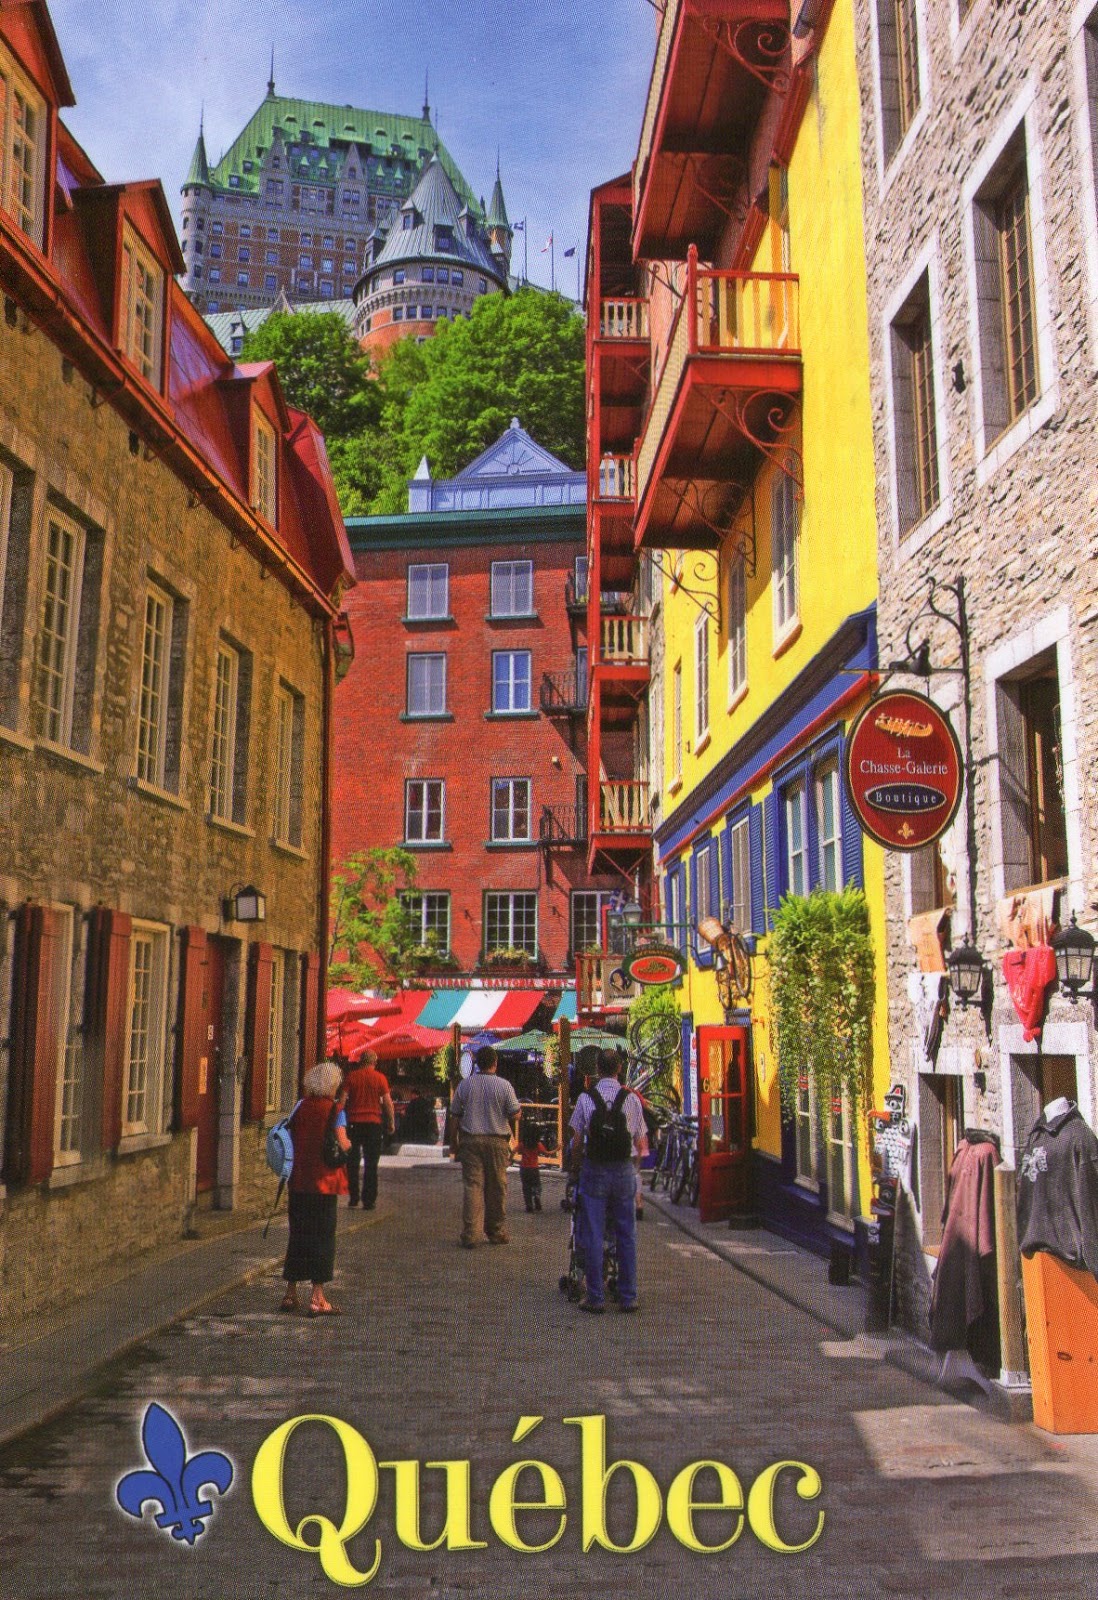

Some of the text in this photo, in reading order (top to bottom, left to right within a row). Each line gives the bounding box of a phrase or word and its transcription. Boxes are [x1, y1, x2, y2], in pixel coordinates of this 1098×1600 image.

[897, 747, 911, 758] La
[860, 760, 948, 774] Chasse-Galerie
[876, 792, 937, 805] Boutique
